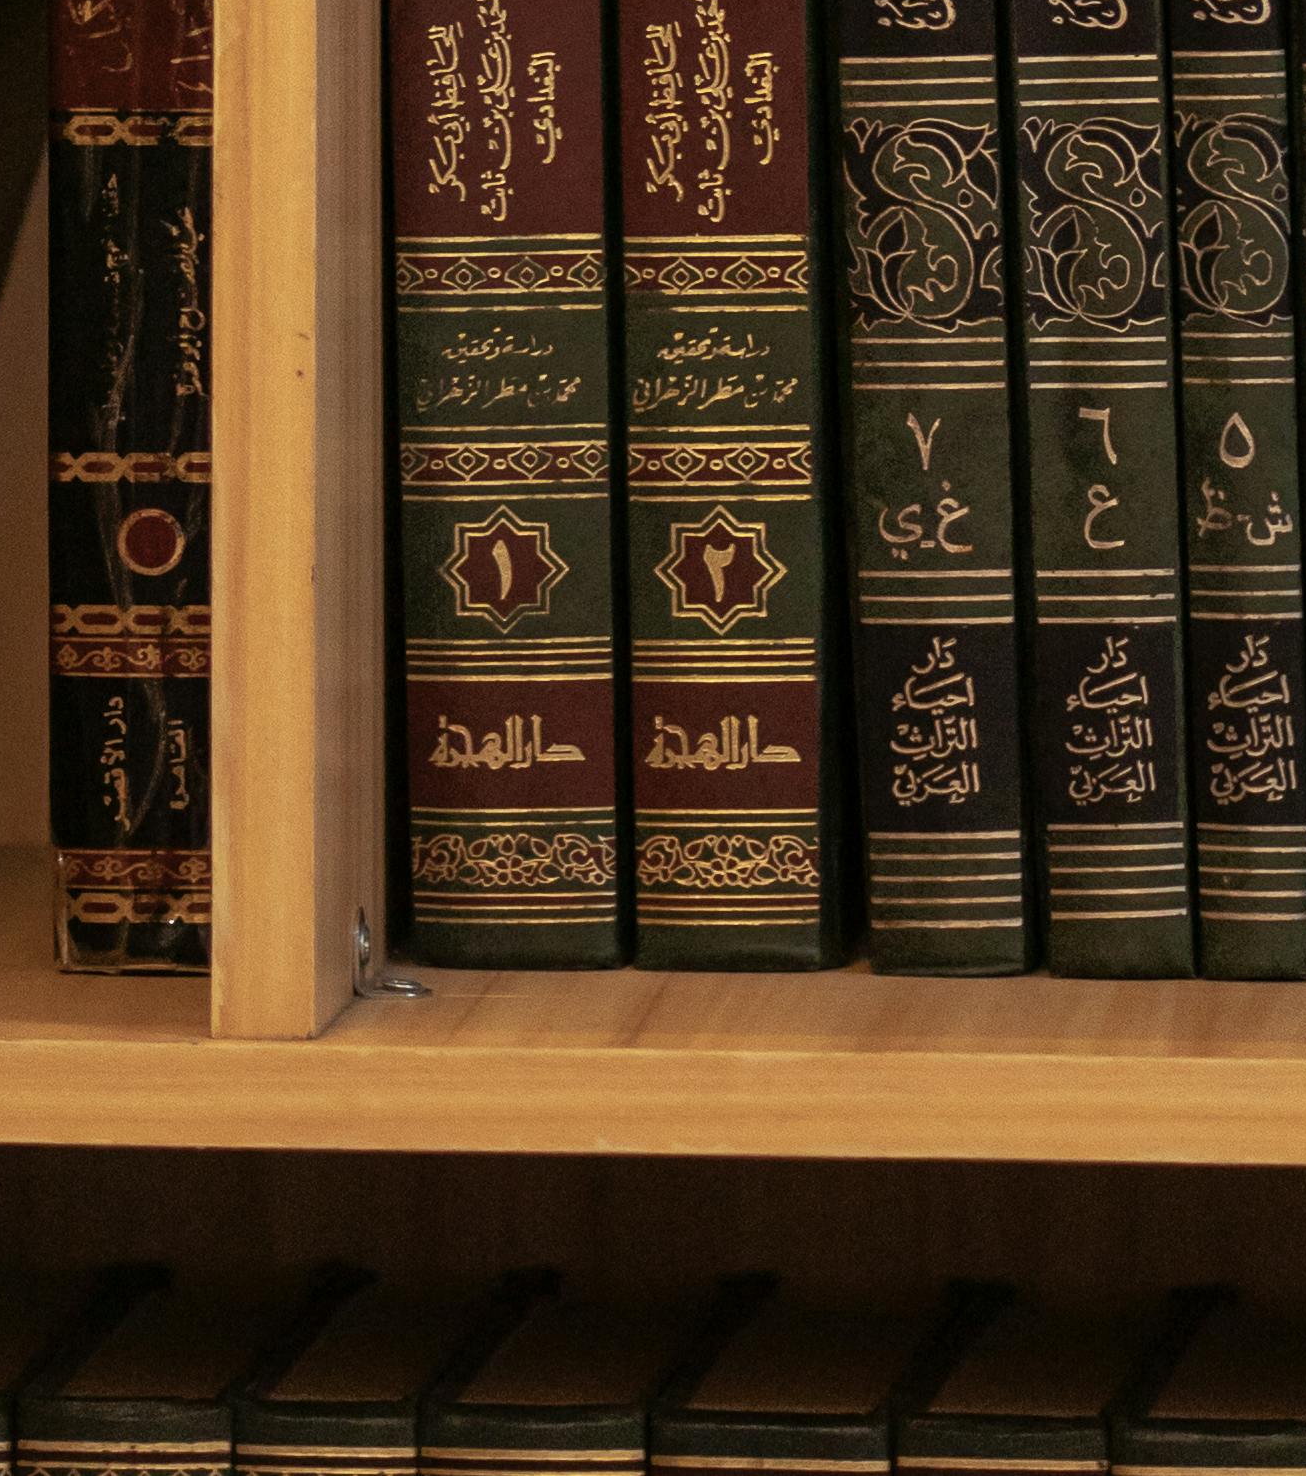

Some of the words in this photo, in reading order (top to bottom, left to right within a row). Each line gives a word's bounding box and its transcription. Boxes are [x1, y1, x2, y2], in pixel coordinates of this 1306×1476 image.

[906, 412, 942, 471] ٧
[1078, 407, 1118, 466] ٦
[1219, 412, 1255, 469] ٥
[491, 539, 513, 601] ١
[702, 543, 736, 603] ٢
